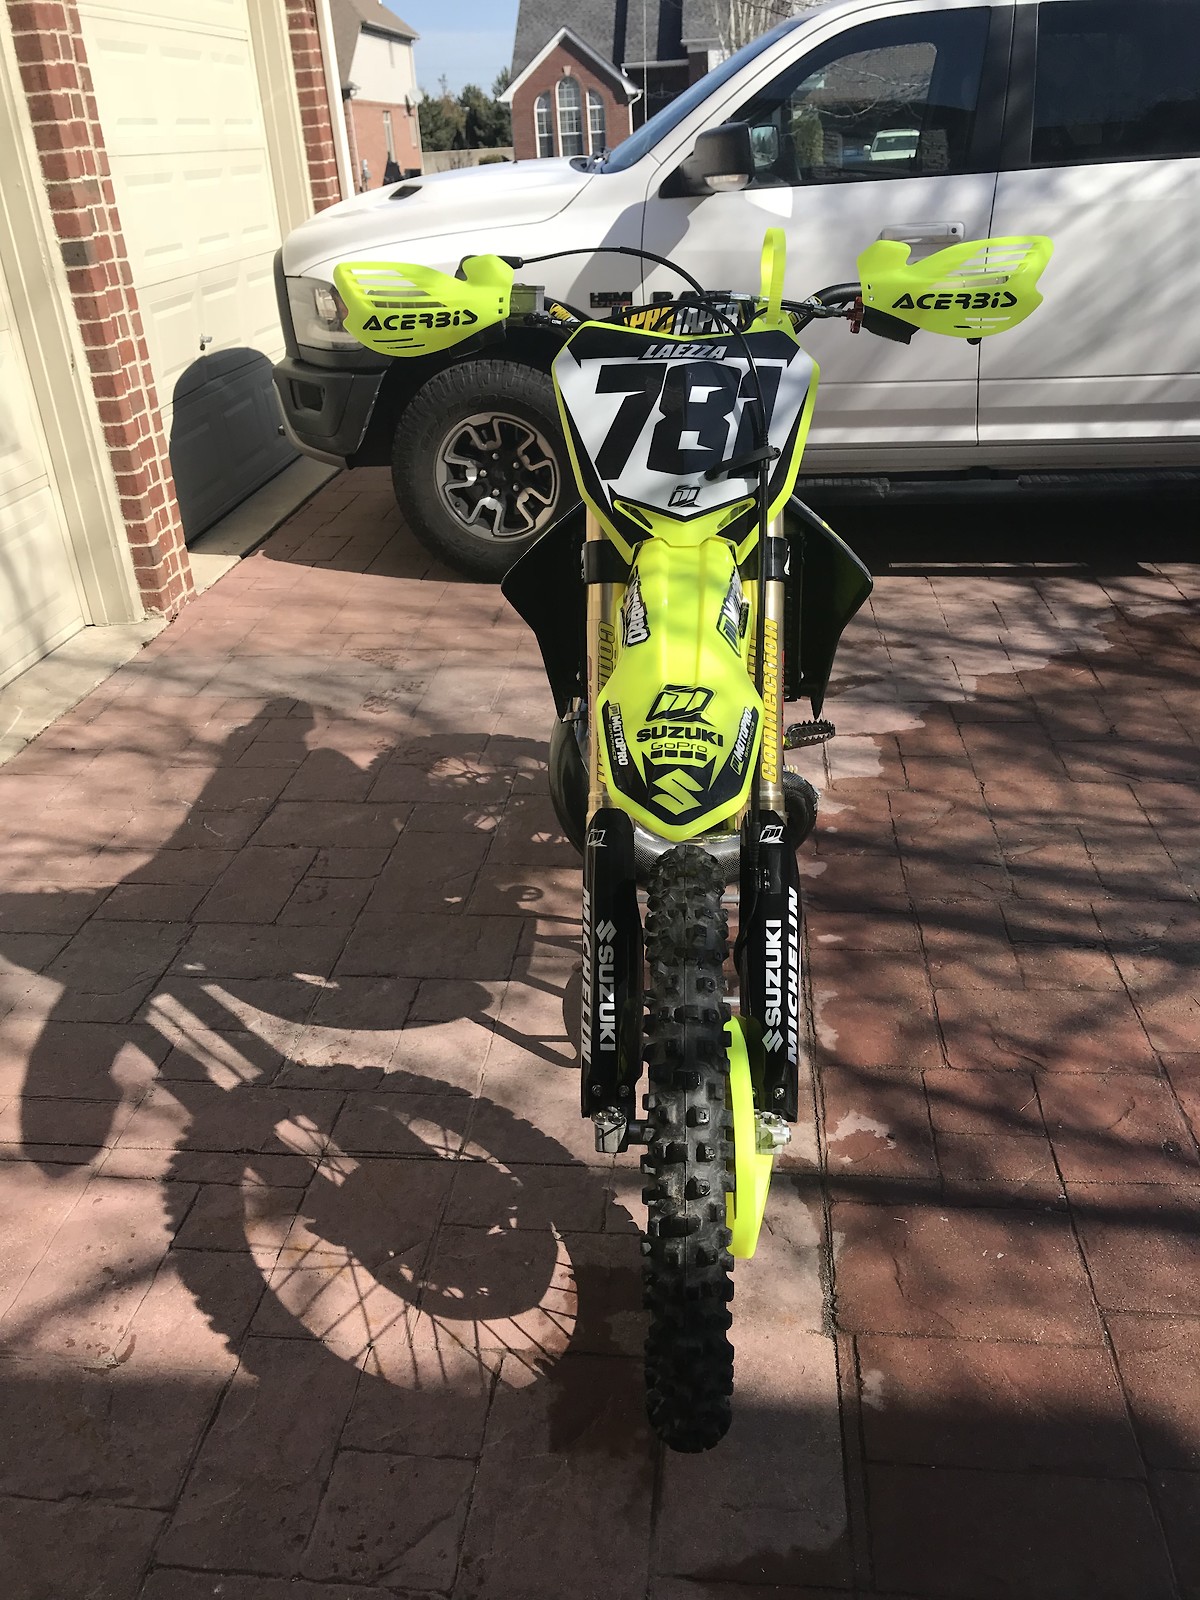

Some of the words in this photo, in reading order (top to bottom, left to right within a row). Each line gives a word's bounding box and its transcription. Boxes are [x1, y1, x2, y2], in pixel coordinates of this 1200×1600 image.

[641, 344, 728, 359] LAEZZA
[594, 360, 783, 480] 781
[611, 716, 629, 766] MOTOPRO
[636, 725, 724, 747] SUZUKI
[651, 742, 708, 753] GoPro
[733, 707, 753, 763] MOTOPRO
[581, 888, 592, 1064] MICHELIN
[598, 945, 616, 1051] SUZUKI
[765, 920, 782, 1027] SUZUKI
[787, 886, 798, 1065] MICHELIN
